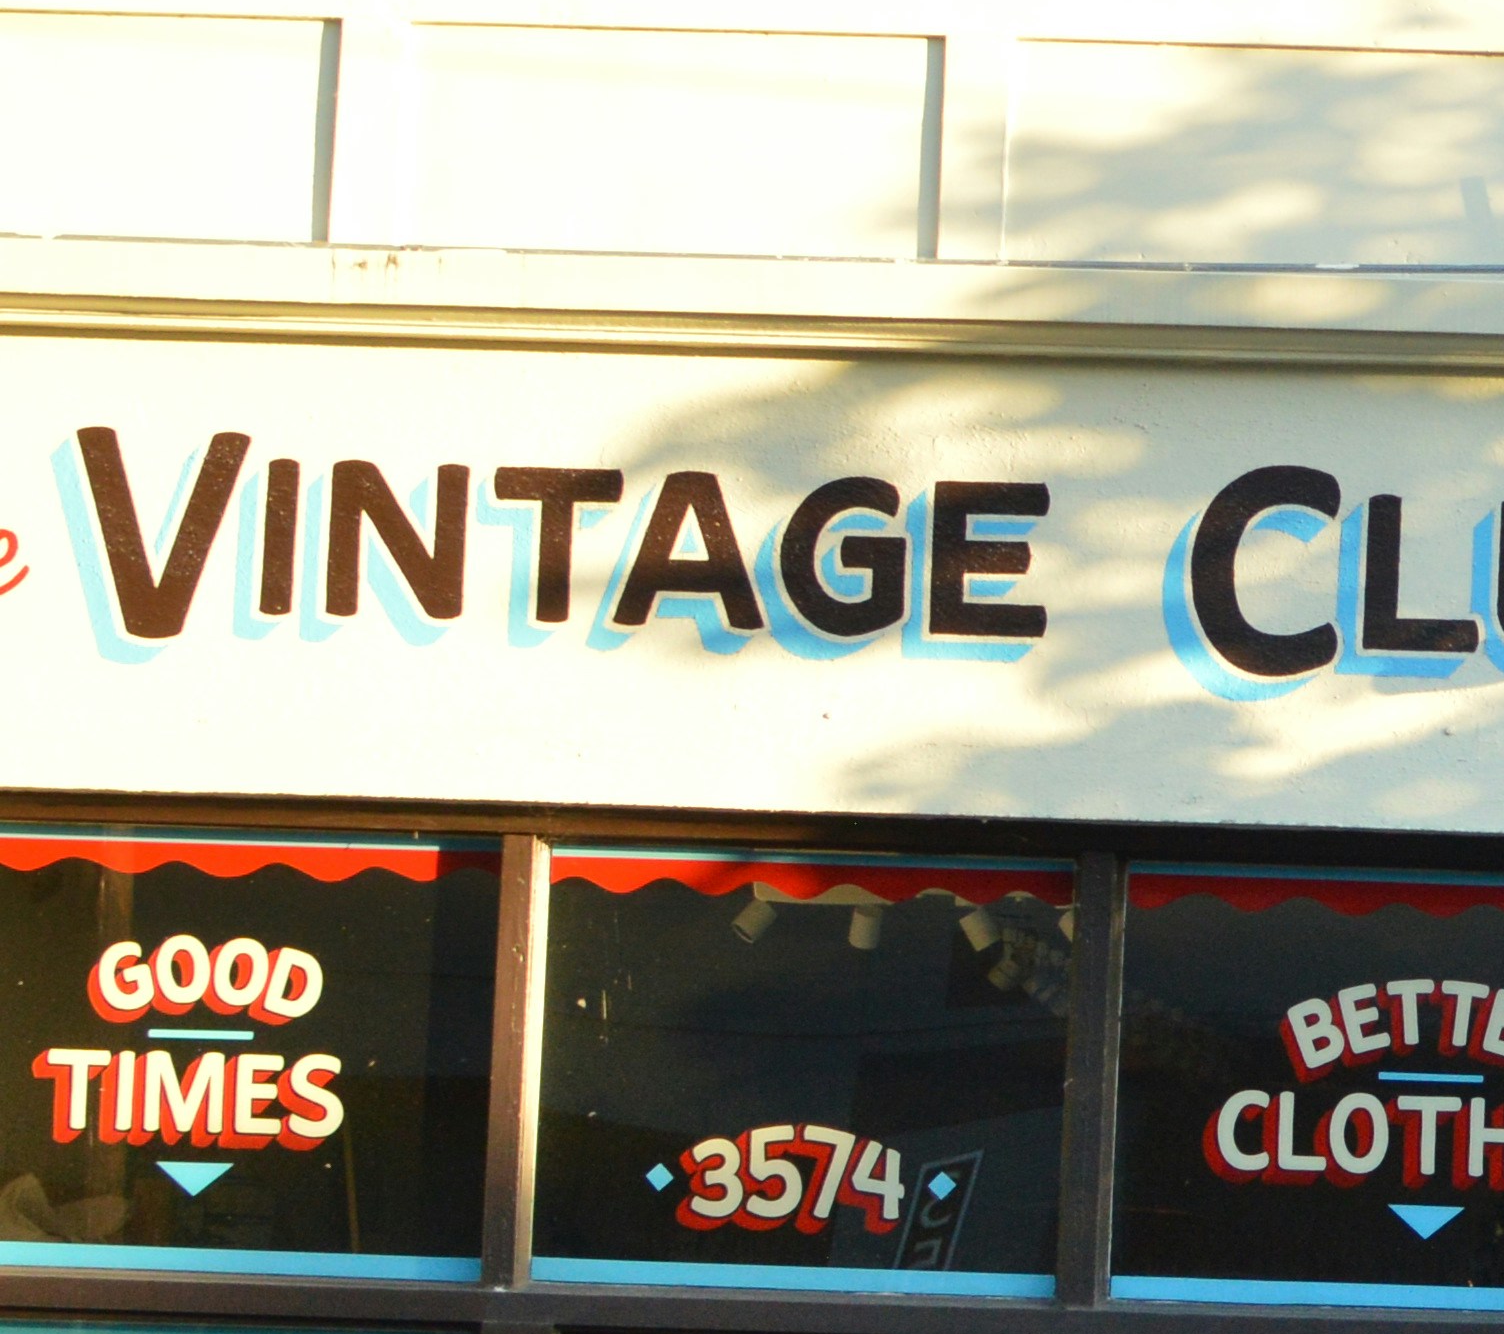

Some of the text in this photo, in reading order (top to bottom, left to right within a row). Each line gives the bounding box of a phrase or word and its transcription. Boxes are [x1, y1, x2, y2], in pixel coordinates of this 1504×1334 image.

[77, 426, 1050, 639] VINTAGE
[96, 934, 324, 1020] GOOD
[44, 1050, 344, 1141] TIMES
[689, 1125, 905, 1221] 3574
